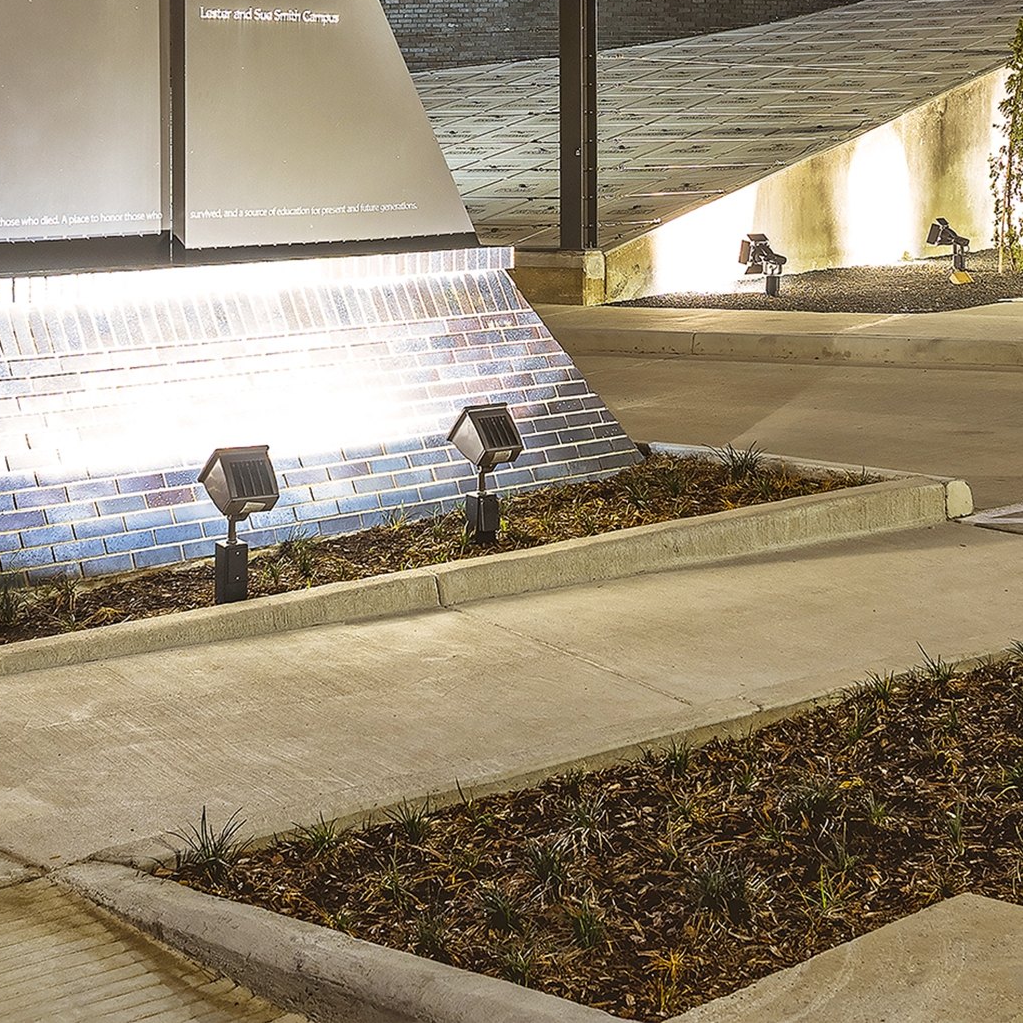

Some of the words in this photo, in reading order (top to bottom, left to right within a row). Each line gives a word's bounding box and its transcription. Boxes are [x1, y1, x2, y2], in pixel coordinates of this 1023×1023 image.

[200, 7, 232, 19] Lester
[233, 8, 253, 20] and
[254, 8, 273, 21] Sue
[274, 9, 301, 23] Smith
[302, 10, 339, 26] Campus
[21, 216, 39, 226] who
[40, 215, 60, 225] died.
[61, 215, 68, 225] A
[68, 214, 89, 226] place
[90, 214, 100, 223] to
[100, 213, 123, 222] honor
[124, 211, 145, 221] those
[145, 210, 163, 221] who
[224, 208, 238, 218] and
[244, 209, 268, 218] source
[268, 206, 277, 217] of
[276, 206, 310, 217] education
[310, 205, 321, 215] for
[321, 205, 346, 216] present
[346, 203, 360, 213] and
[360, 203, 379, 213] future
